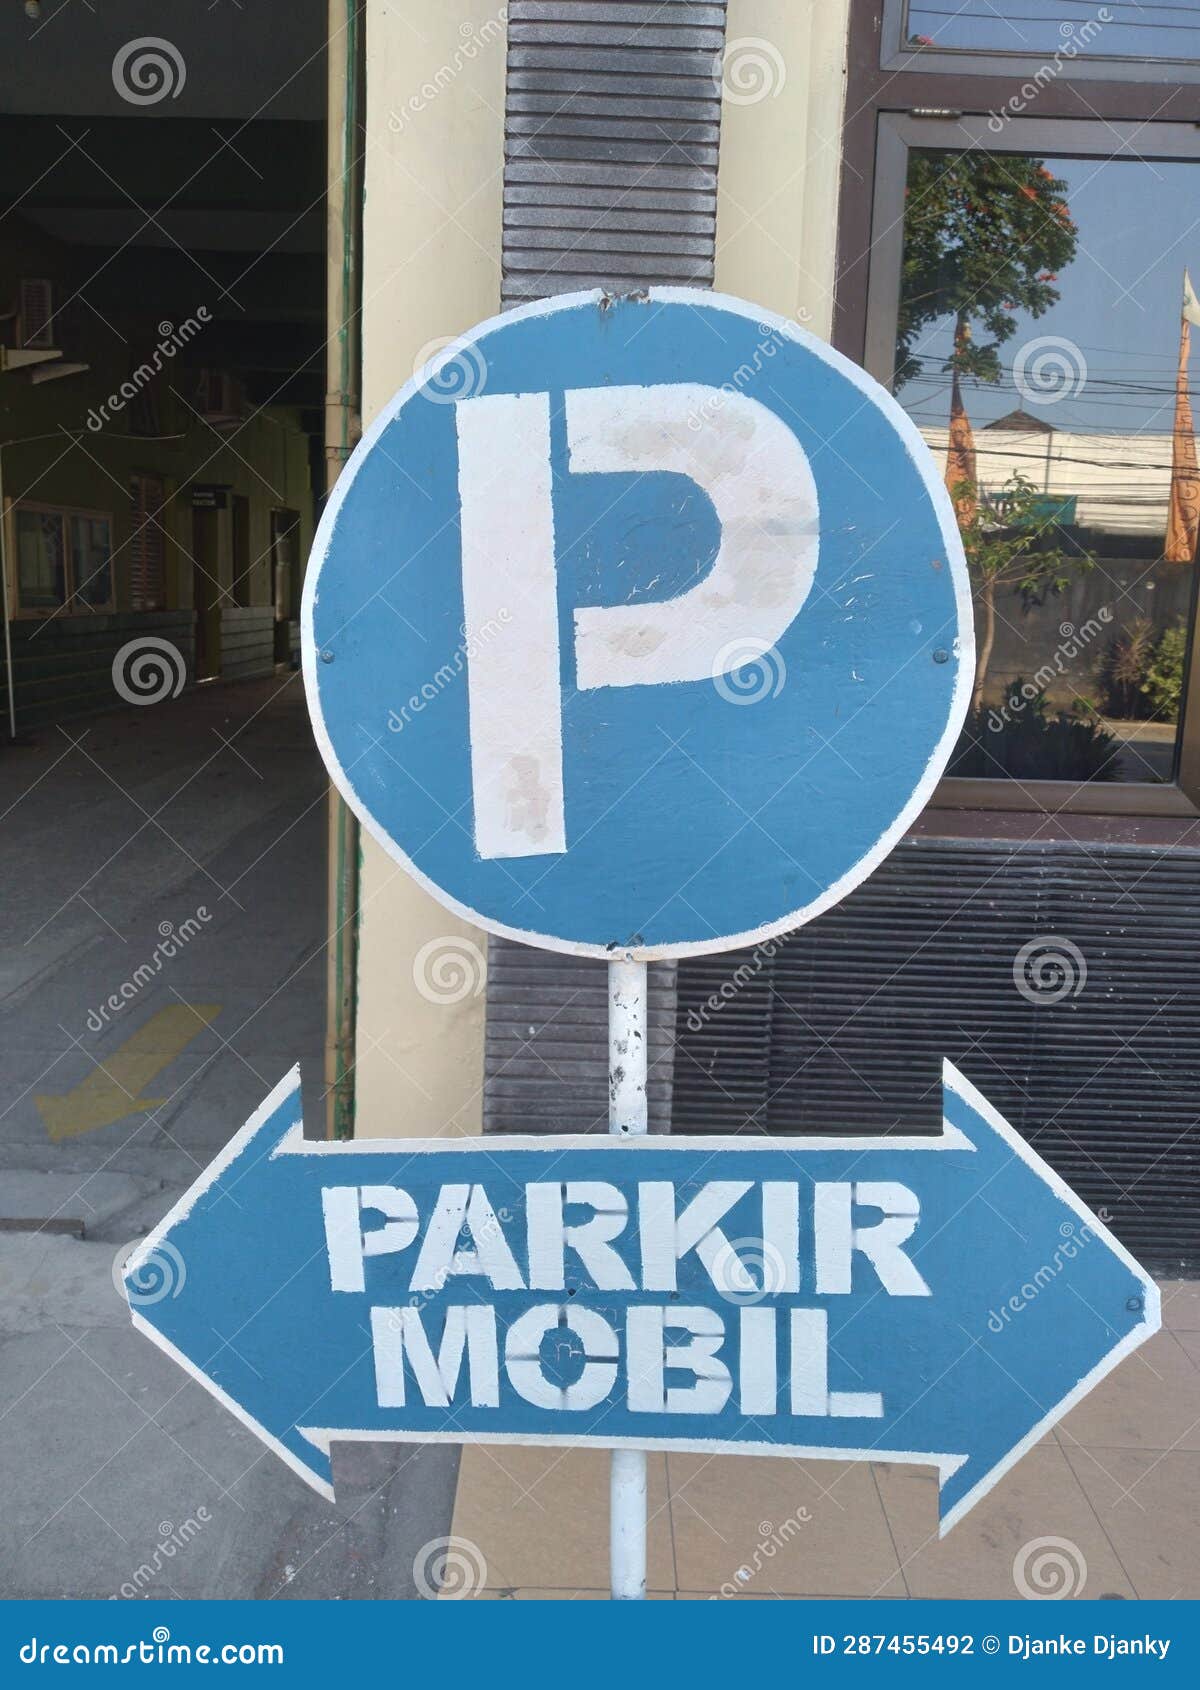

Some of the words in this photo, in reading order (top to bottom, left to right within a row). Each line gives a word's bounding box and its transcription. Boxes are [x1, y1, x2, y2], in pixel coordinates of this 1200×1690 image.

[455, 384, 819, 860] P
[321, 1181, 932, 1297] PARKIR
[370, 1304, 884, 1418] MOBIL
